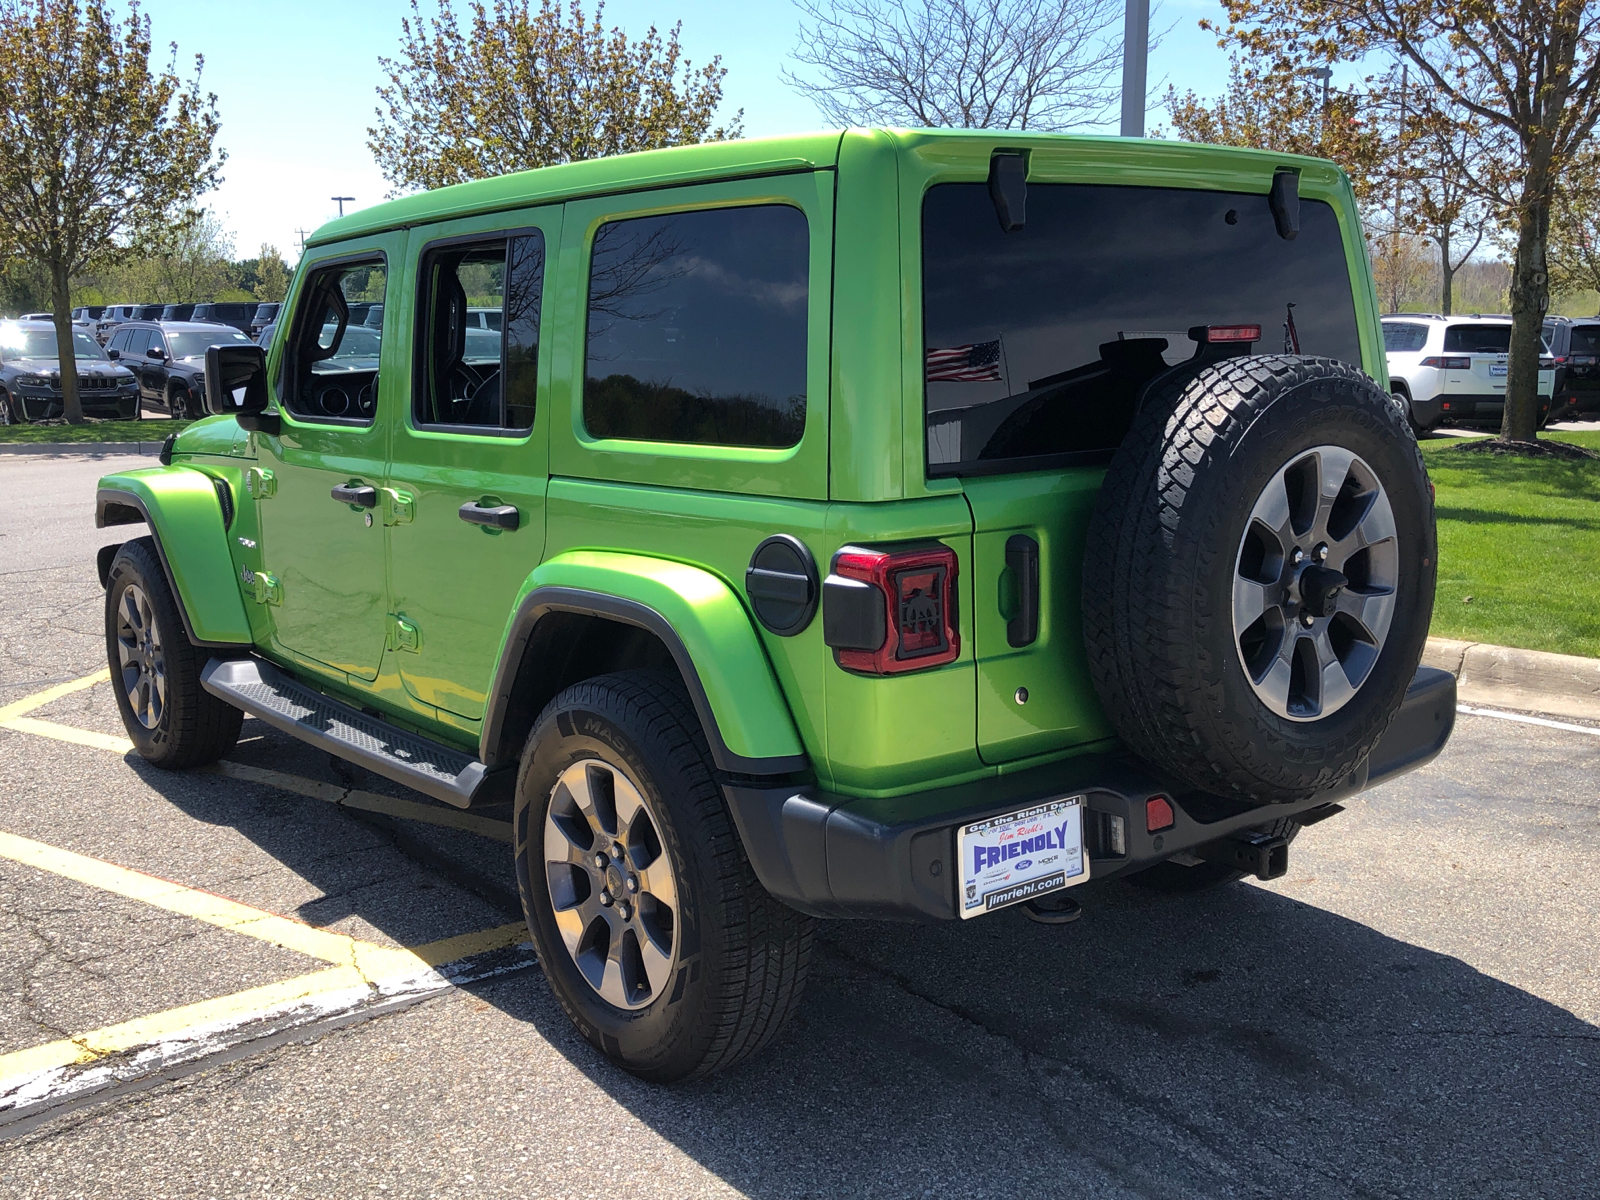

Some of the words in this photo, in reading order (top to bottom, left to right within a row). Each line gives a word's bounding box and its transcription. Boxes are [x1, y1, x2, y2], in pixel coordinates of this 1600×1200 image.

[1237, 404, 1399, 508] RDGESTONE
[240, 563, 255, 586] Jee
[583, 716, 697, 931] MASTERCRAFT
[969, 821, 991, 833] Get
[994, 816, 1013, 826] the
[1017, 806, 1047, 819] Riehl
[1050, 798, 1076, 810] Deal
[974, 820, 1068, 875] FRIENDLY
[998, 831, 1015, 845] Jim
[1016, 823, 1044, 836] Riehl's
[1017, 861, 1031, 870] Ford
[1038, 855, 1059, 865] MOKE
[988, 875, 1064, 909] jimriehl.com
[530, 933, 590, 1038] STRATUS
